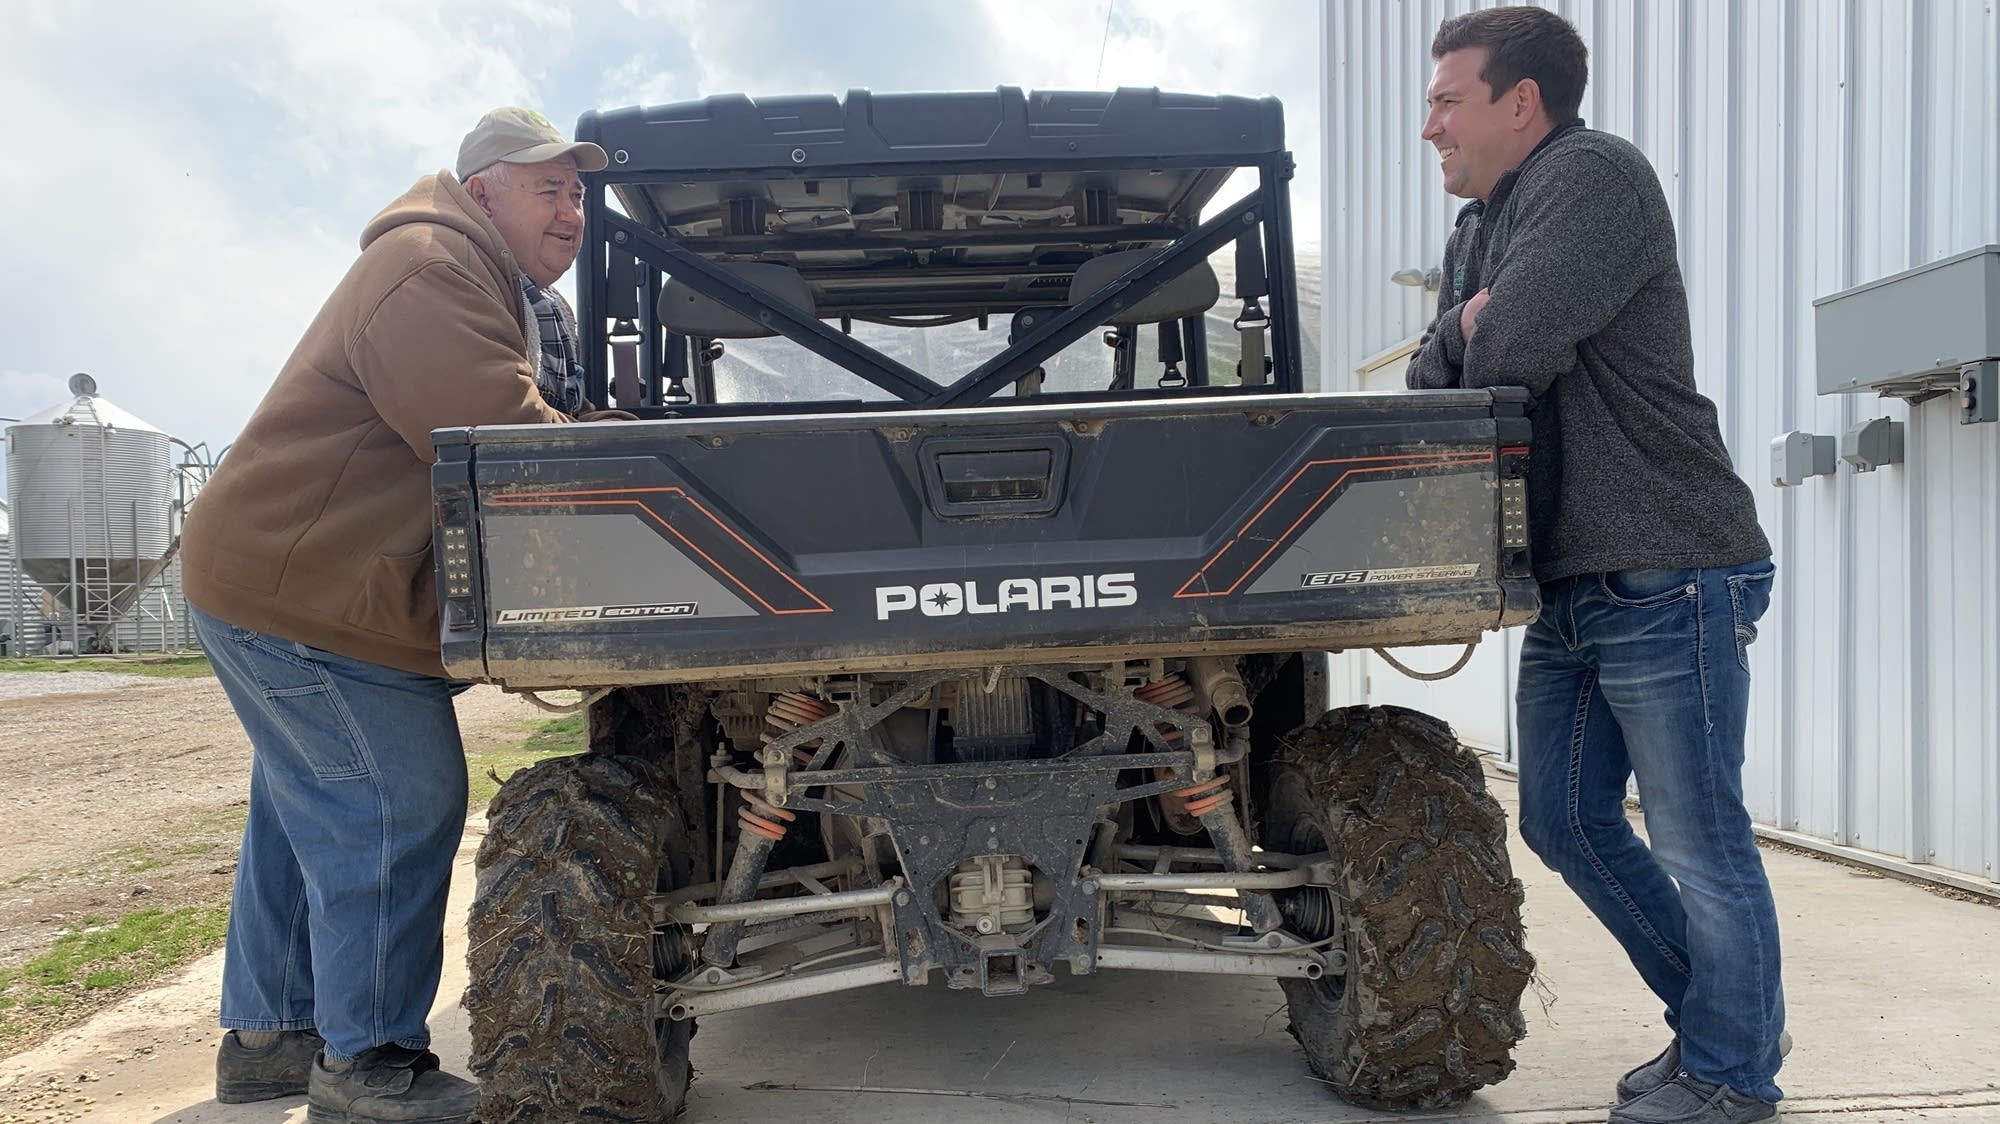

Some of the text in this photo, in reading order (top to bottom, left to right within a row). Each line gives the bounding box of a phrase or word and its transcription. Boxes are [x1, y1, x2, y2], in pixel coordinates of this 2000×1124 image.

[1310, 571, 1363, 585] EPS
[1370, 572, 1414, 581] POWER
[1416, 569, 1473, 579] STEERING
[875, 573, 1139, 621] POLARIS
[502, 605, 690, 621] LIMITED EDITION
